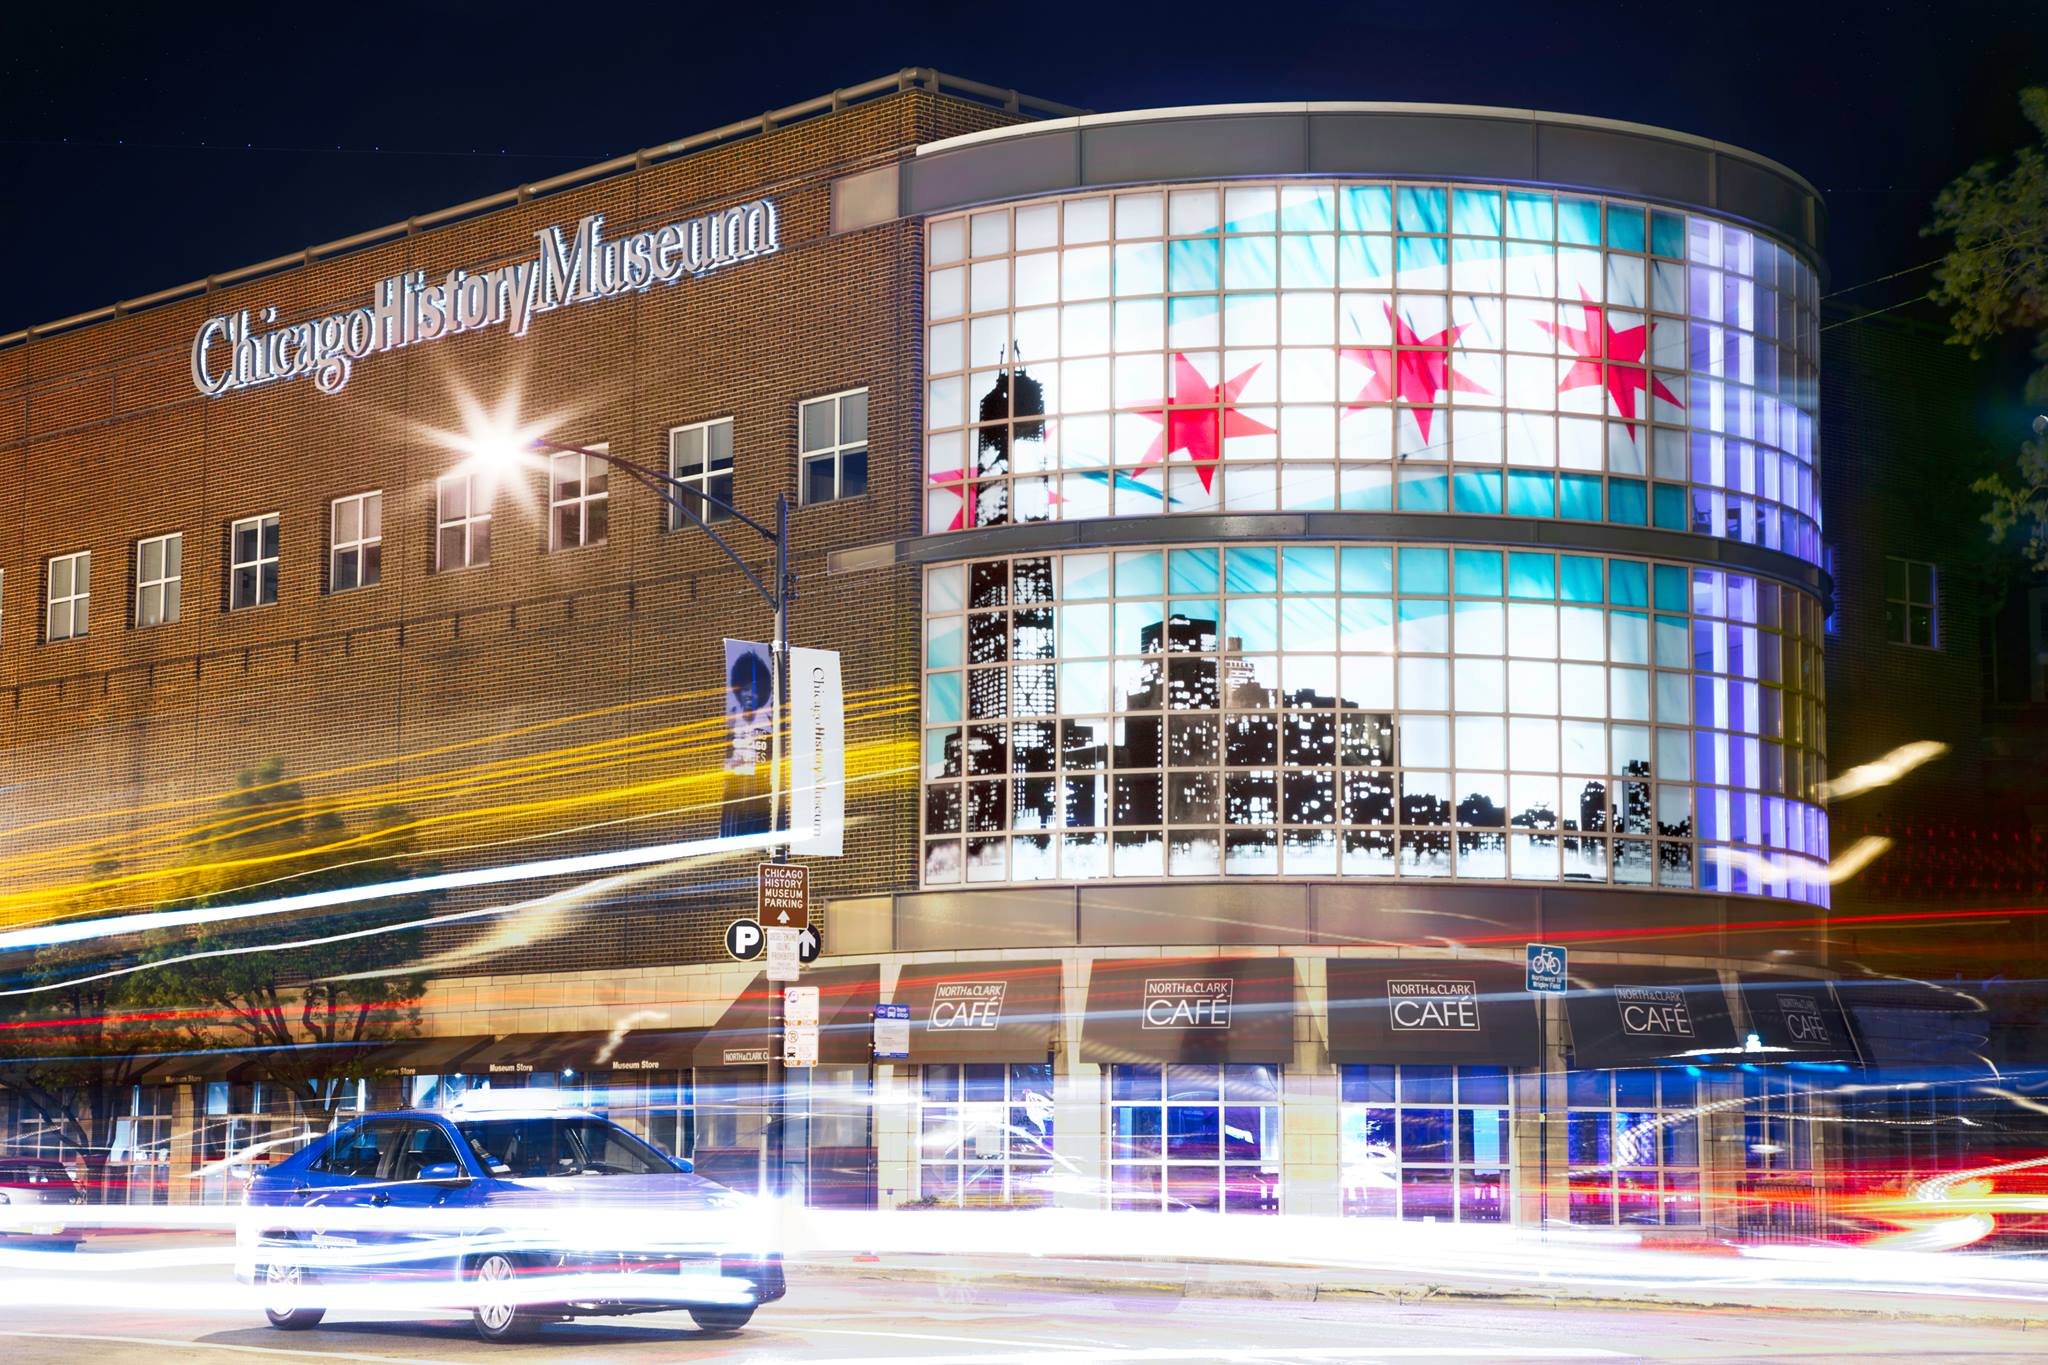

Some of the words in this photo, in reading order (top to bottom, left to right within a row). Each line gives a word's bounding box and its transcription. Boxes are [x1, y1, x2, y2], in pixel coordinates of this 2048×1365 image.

[764, 868, 803, 879] CHICAGO
[764, 878, 803, 889] HISTORY
[764, 888, 803, 899] MUSEUM
[764, 898, 804, 909] PARKING
[736, 926, 760, 954] P
[933, 996, 999, 1027] CAFÉ
[1146, 993, 1227, 1025] CAFÉ
[1394, 995, 1476, 1027] CAFÉ
[1624, 1003, 1691, 1033] CAFÉ
[489, 1063, 515, 1072] Museum
[516, 1063, 533, 1072] Store
[612, 1061, 640, 1070] Museum
[641, 1060, 660, 1069] Store
